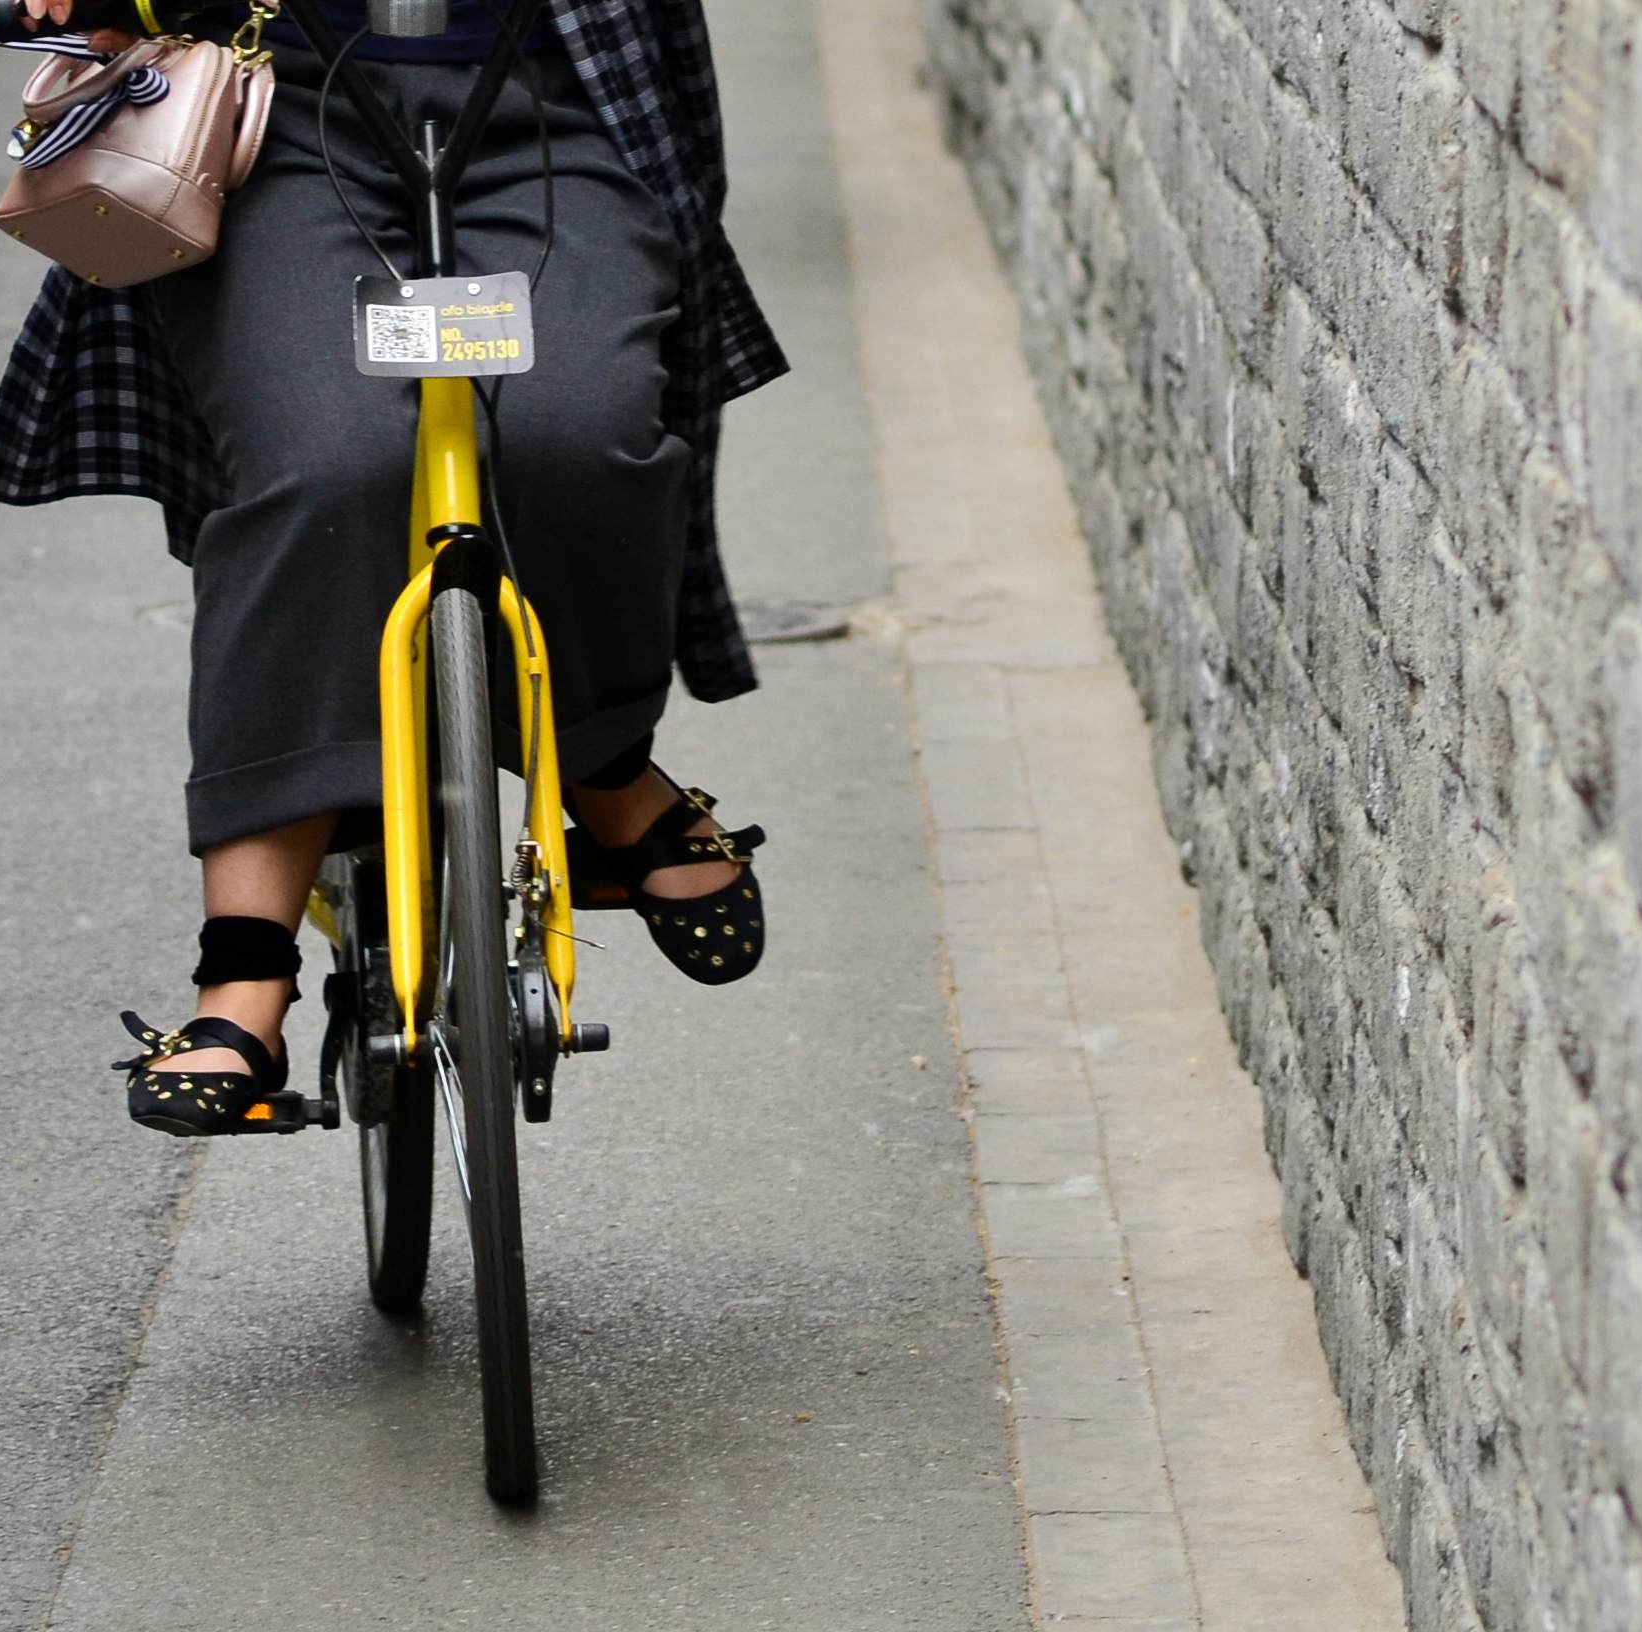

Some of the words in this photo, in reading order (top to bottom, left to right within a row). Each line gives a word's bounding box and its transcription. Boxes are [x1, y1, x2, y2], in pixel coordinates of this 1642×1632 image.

[440, 304, 464, 317] ofo
[466, 300, 514, 316] bicycle
[442, 338, 519, 362] 2495130
